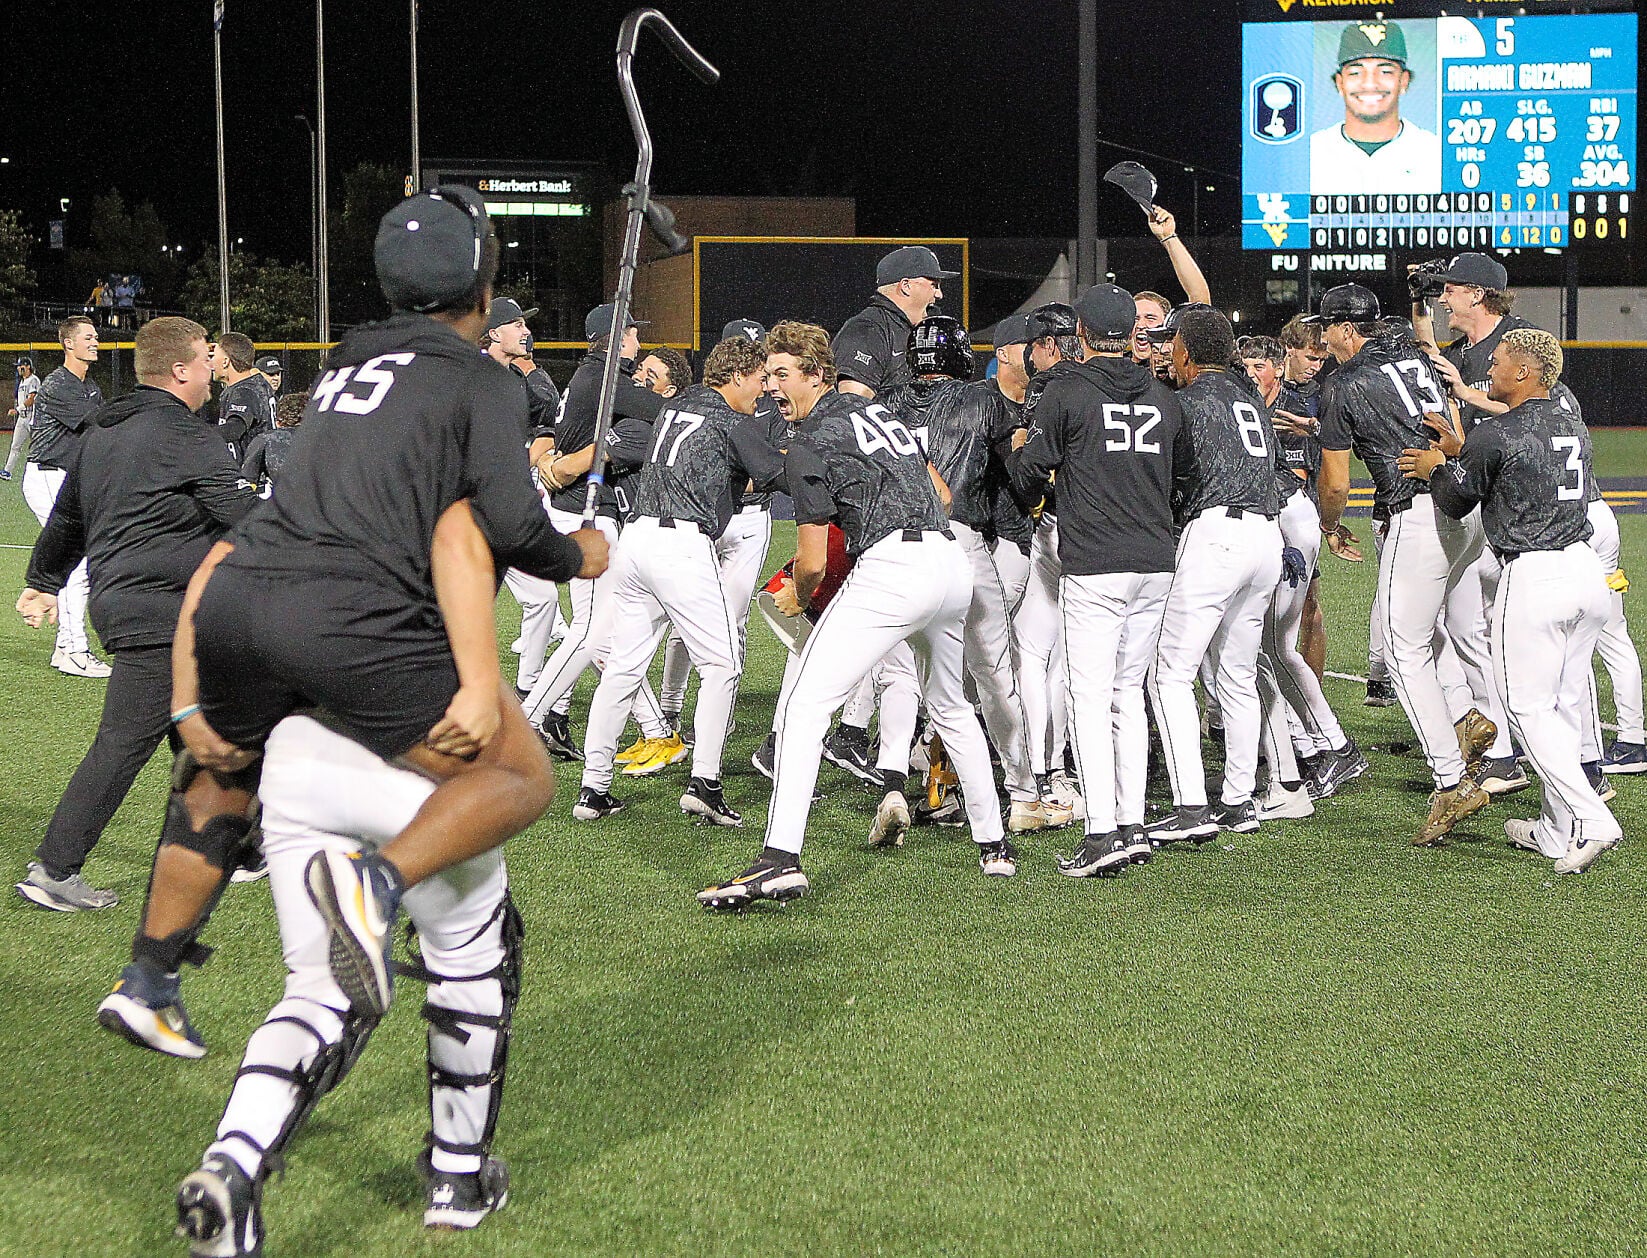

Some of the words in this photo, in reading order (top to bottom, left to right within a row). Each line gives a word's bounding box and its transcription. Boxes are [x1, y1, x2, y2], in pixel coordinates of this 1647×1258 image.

[1496, 18, 1515, 56] 5
[1519, 62, 1592, 90] GUZMAN
[1459, 100, 1482, 116] AB
[1516, 99, 1552, 115] SLG.
[1590, 98, 1618, 113] RBI
[1447, 118, 1497, 144] 207
[1506, 117, 1557, 143] 415
[1586, 116, 1620, 141] 37
[1455, 147, 1486, 162] HRs
[1523, 146, 1545, 161] SB
[1583, 144, 1623, 160] AVG.
[479, 179, 538, 192] &Herbert
[539, 180, 571, 193] Bank
[1461, 163, 1480, 188] 0
[1516, 161, 1550, 187] 36
[1571, 160, 1630, 187] .304
[1316, 195, 1327, 213] 0
[1336, 195, 1347, 213] 0
[1358, 195, 1366, 212] 1
[1376, 195, 1388, 213] 0
[1396, 195, 1408, 213] 0
[1417, 195, 1428, 213] 0
[1437, 194, 1449, 212] 4
[1458, 194, 1469, 212] 0
[1478, 193, 1490, 212] 0
[1501, 193, 1512, 211] 5
[1525, 193, 1536, 210] 9
[1552, 193, 1560, 210] 1
[1316, 228, 1327, 246] 0
[1337, 228, 1345, 246] 1
[1356, 228, 1367, 246] 0
[1376, 228, 1387, 246] 2
[1398, 228, 1405, 246] 1
[1417, 228, 1428, 246] 0
[1437, 227, 1448, 245] 0
[1458, 227, 1469, 246] 0
[1479, 227, 1487, 246] 1
[1501, 227, 1512, 244] 6
[1522, 227, 1541, 244] 12
[1550, 226, 1561, 244] 0
[1573, 217, 1586, 238] 0
[1595, 217, 1608, 238] 0
[1618, 217, 1627, 238] 1
[1379, 358, 1444, 418] 13
[651, 409, 706, 467] 17
[849, 403, 919, 460] 46
[1101, 403, 1162, 454] 52
[1232, 401, 1268, 457] 8
[1551, 436, 1584, 501] 3
